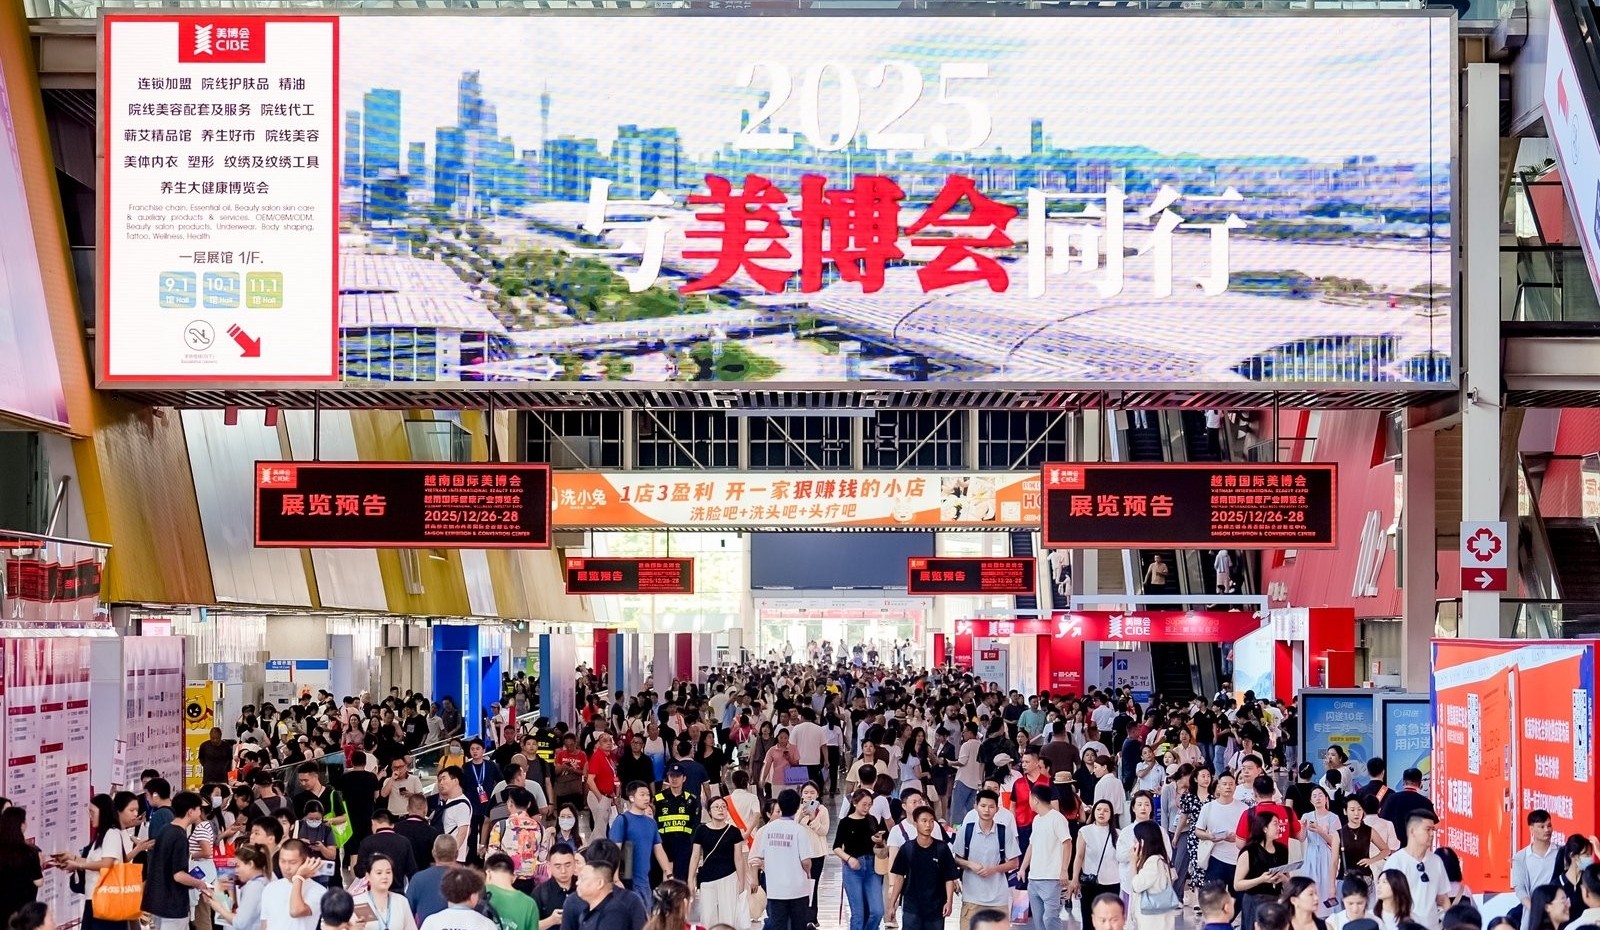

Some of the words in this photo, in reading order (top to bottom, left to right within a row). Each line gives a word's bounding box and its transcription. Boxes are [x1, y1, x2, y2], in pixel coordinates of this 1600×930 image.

[216, 28, 250, 38] 美博会
[216, 40, 250, 51] CIBE
[138, 77, 192, 90] 连锁加盟
[201, 77, 270, 90] 院线护肤品
[278, 77, 306, 90] 精油
[128, 104, 252, 116] 院线美容配套及服务
[260, 104, 315, 116] 院线代工
[736, 61, 993, 151] 2025
[124, 130, 192, 142] 蕲艾精品馆
[201, 130, 256, 142] 养生好市
[265, 130, 320, 142] 院线美容
[124, 156, 178, 168] 美体内衣
[188, 156, 214, 168] 塑形
[224, 156, 320, 168] 纹绣及纹绣工具
[160, 181, 270, 194] 养生大健康博览会
[234, 204, 260, 213] Beauty
[171, 214, 204, 222] products
[126, 223, 152, 231] Beauty
[262, 223, 280, 231] Body
[186, 232, 210, 240] Health
[566, 173, 1247, 298] 与美博会同行
[179, 251, 233, 264] 一层展馆
[238, 251, 264, 264] 1/F.
[166, 278, 188, 292] 9.1
[207, 278, 234, 292] 10.1
[250, 278, 277, 292] 11.1
[176, 296, 190, 304] Hall
[424, 474, 522, 487] 越南国际美博会
[1211, 474, 1307, 487] 越南国际美博会
[620, 481, 714, 503] 1店3盈利
[726, 478, 926, 502] 开一家狠赚钱的小店
[424, 495, 521, 504] 越南国际健康产业博览会
[560, 488, 606, 506] 洗小兔
[1211, 496, 1306, 504] 越南国际健康产业博览会
[281, 494, 387, 516] 展览预告
[1070, 495, 1174, 517] 展览预告
[424, 510, 518, 522] 2025/12/26-28
[690, 502, 857, 521] 洗脸吧+洗头吧+头疗吧
[1211, 510, 1304, 523] 2025/12/26-28
[578, 571, 623, 581] 展览预告
[920, 571, 966, 581] 展览预告
[1125, 617, 1151, 626] 美博会
[1125, 627, 1150, 635] CIBE
[1326, 712, 1364, 722] 闪送10年
[1395, 738, 1430, 750] 用闪送
[662, 807, 685, 815] 安保
